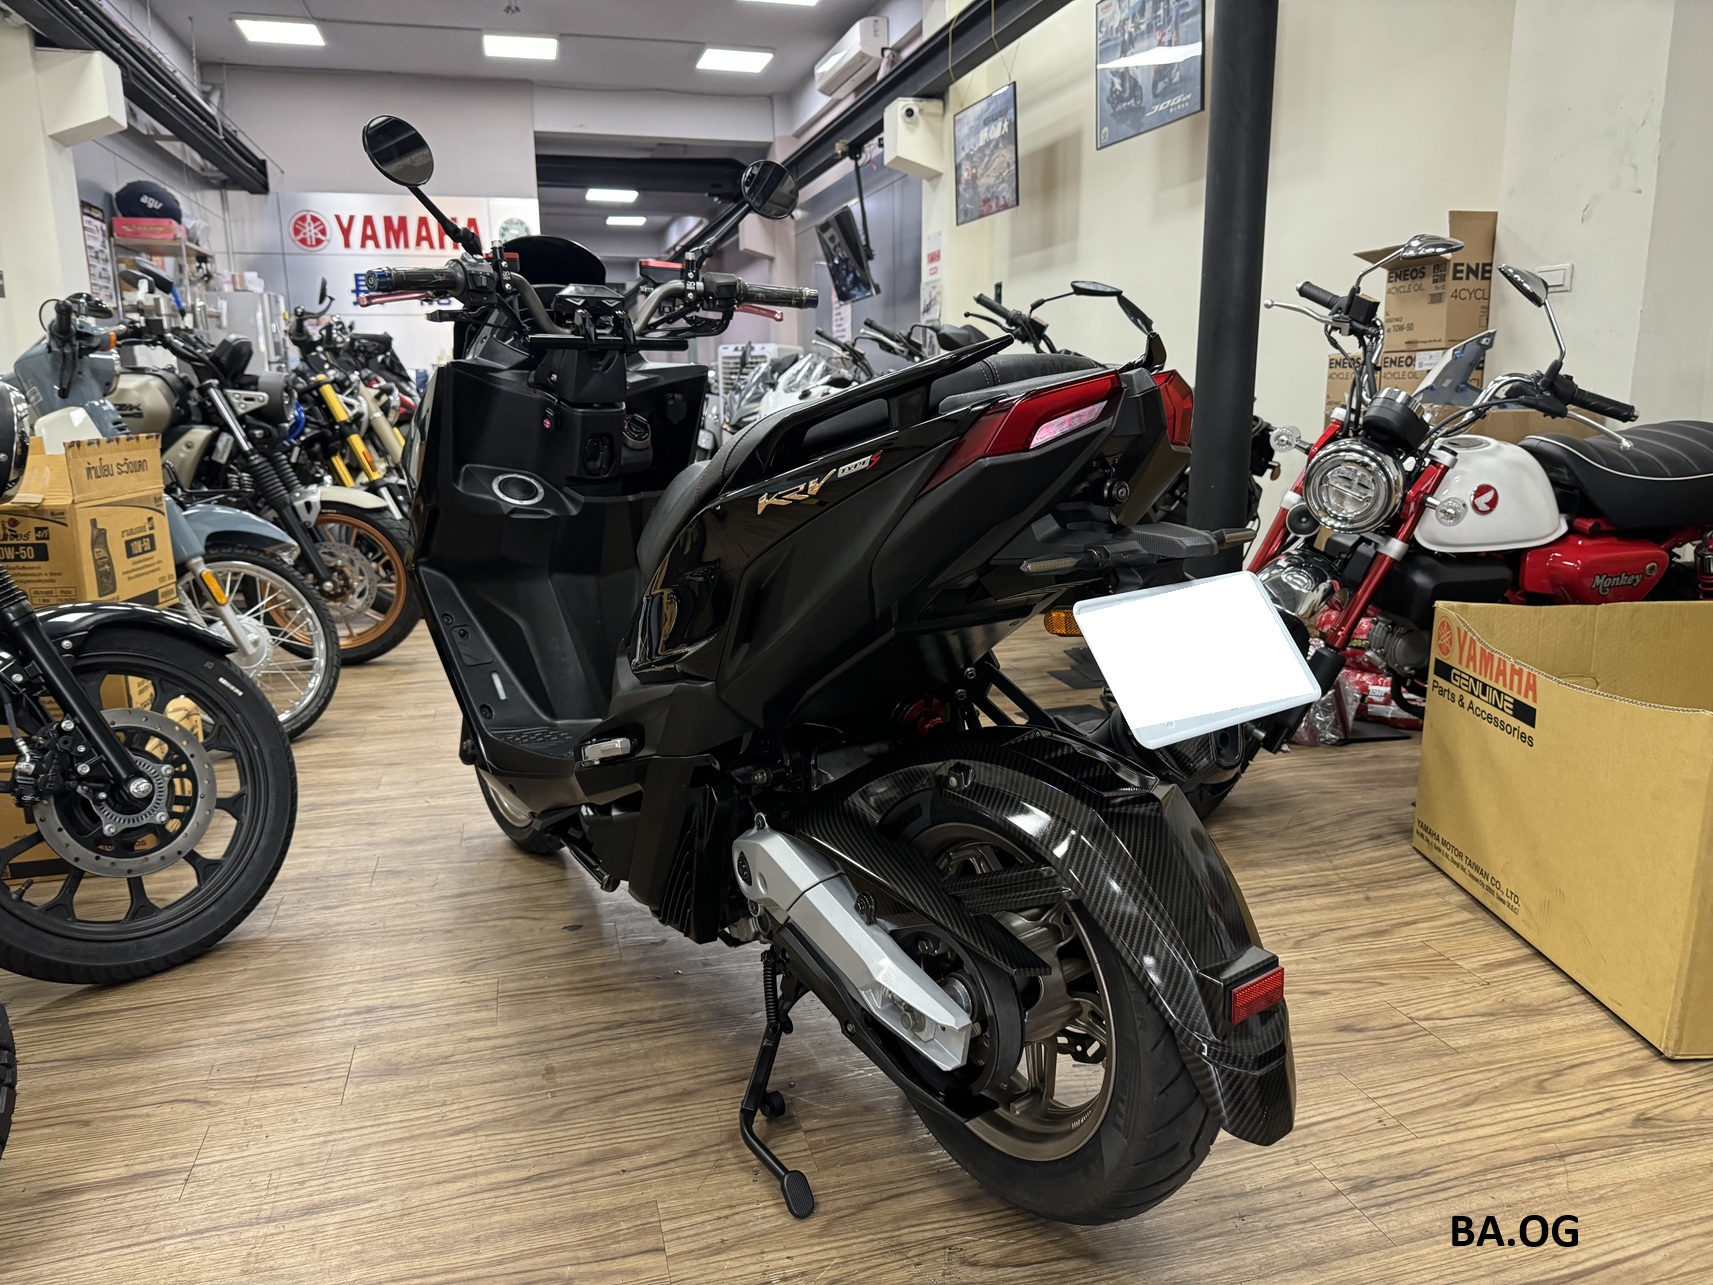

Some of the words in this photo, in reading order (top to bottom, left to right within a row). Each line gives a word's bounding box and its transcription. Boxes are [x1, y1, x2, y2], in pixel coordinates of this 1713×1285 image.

[1388, 267, 1426, 283] ENEOS
[1387, 284, 1412, 294] 4CYCLE
[1413, 282, 1425, 292] OIL
[1451, 288, 1489, 301] 4CYCL
[1328, 357, 1362, 369] ENEOS
[1383, 371, 1406, 380] 4CYCLE
[1407, 370, 1420, 379] OIL
[757, 468, 837, 515] KRV
[1591, 571, 1643, 596] Monkey
[1457, 626, 1538, 705] YAMAHA
[1450, 668, 1515, 716] GENUINE
[1431, 680, 1456, 704] Parts
[1459, 694, 1465, 709] &
[1467, 700, 1535, 747] Accessories
[1417, 818, 1440, 843] YAMAHA
[1441, 837, 1464, 861] MOTOR
[1464, 855, 1489, 882] TAIWAN
[1505, 888, 1521, 907] LTD.
